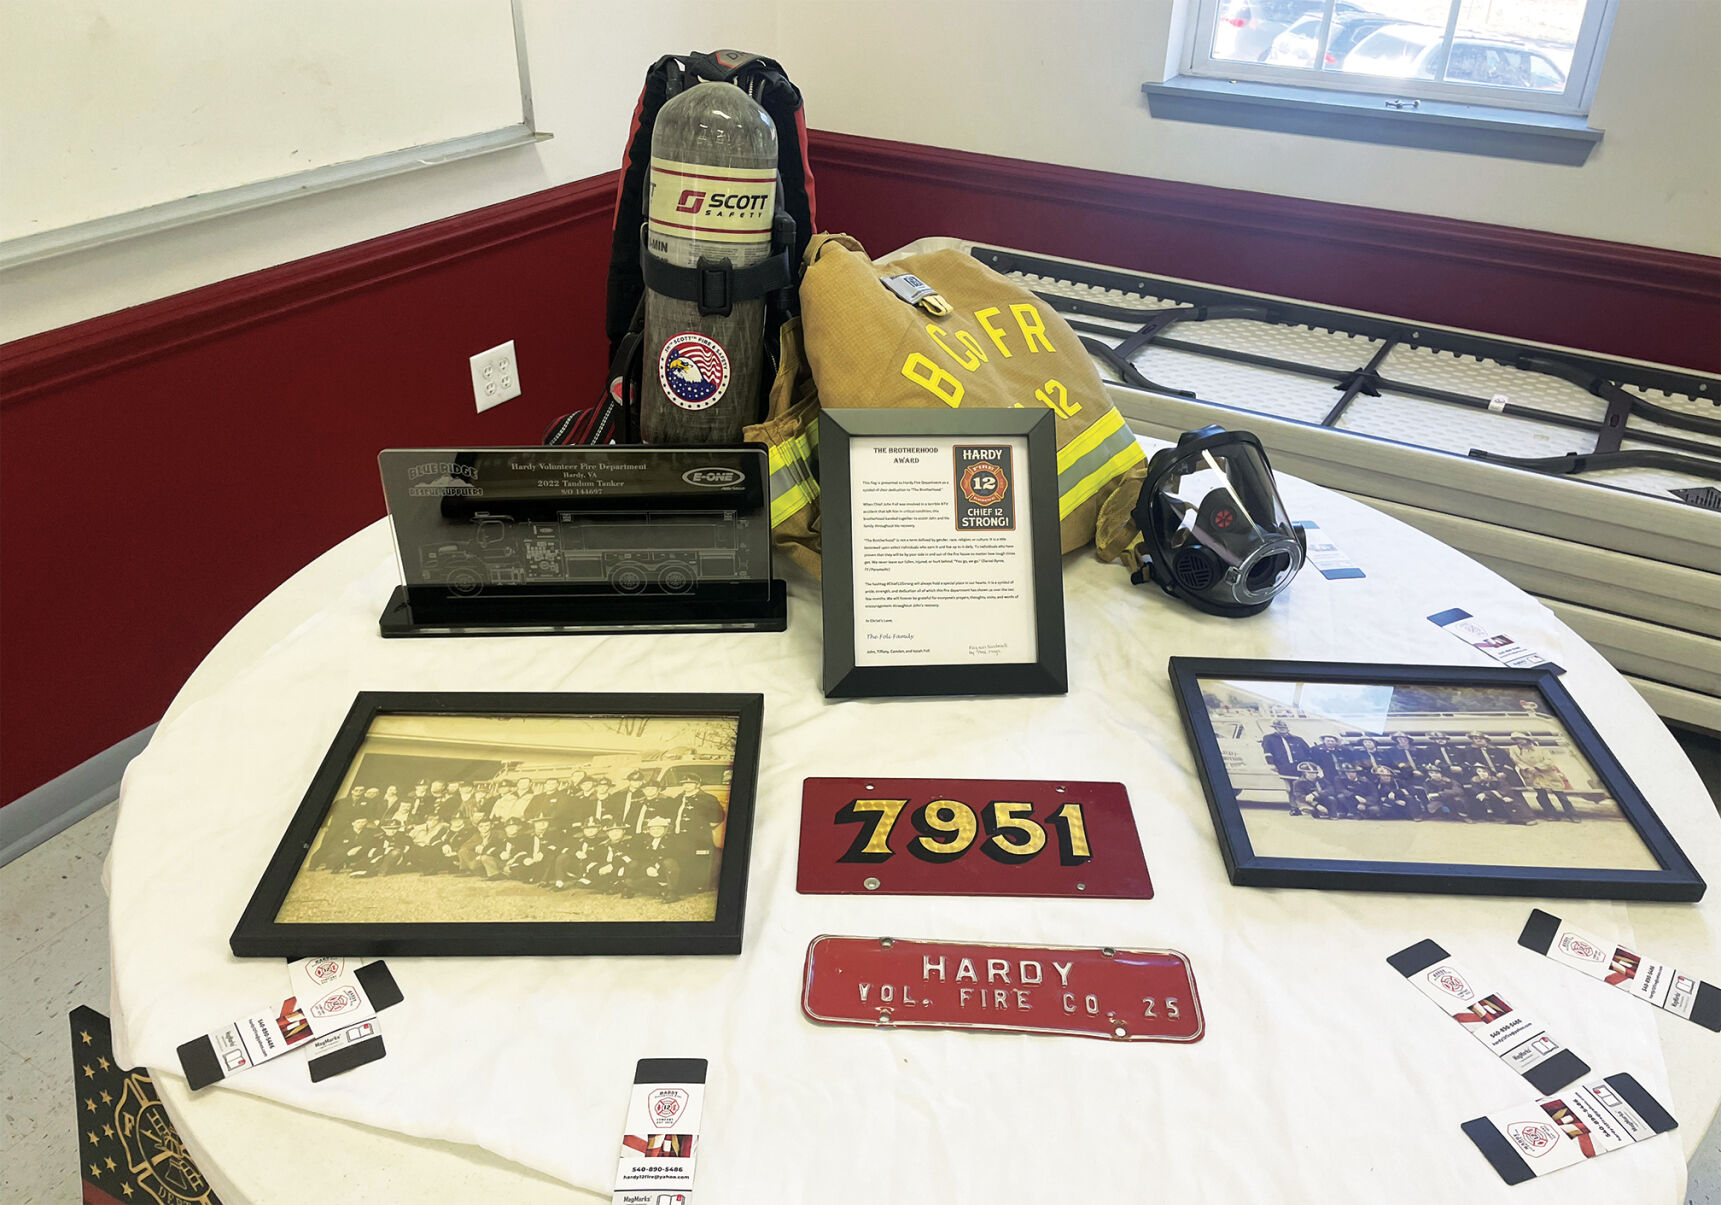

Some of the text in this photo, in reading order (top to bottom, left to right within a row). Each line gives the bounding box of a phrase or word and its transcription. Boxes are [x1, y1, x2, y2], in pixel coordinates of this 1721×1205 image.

[708, 193, 769, 211] SCOTT
[705, 210, 763, 218] SAFETY
[698, 337, 712, 346] FIRE
[716, 349, 728, 370] SAFETY
[1034, 378, 1082, 419] 12
[963, 450, 1002, 460] HARDY
[408, 462, 478, 480] BLUE RIDGE
[512, 463, 536, 471] Hardy
[600, 463, 647, 471] Department
[693, 472, 734, 481] E-ONE
[973, 476, 996, 490] 12
[409, 488, 483, 496] RESCUE SUPPLIERS
[962, 517, 1009, 527] STRONG!
[838, 798, 1092, 863] 7951
[923, 956, 1072, 986] HARDY
[858, 983, 1180, 1019] VOL. FIRE CO. 25
